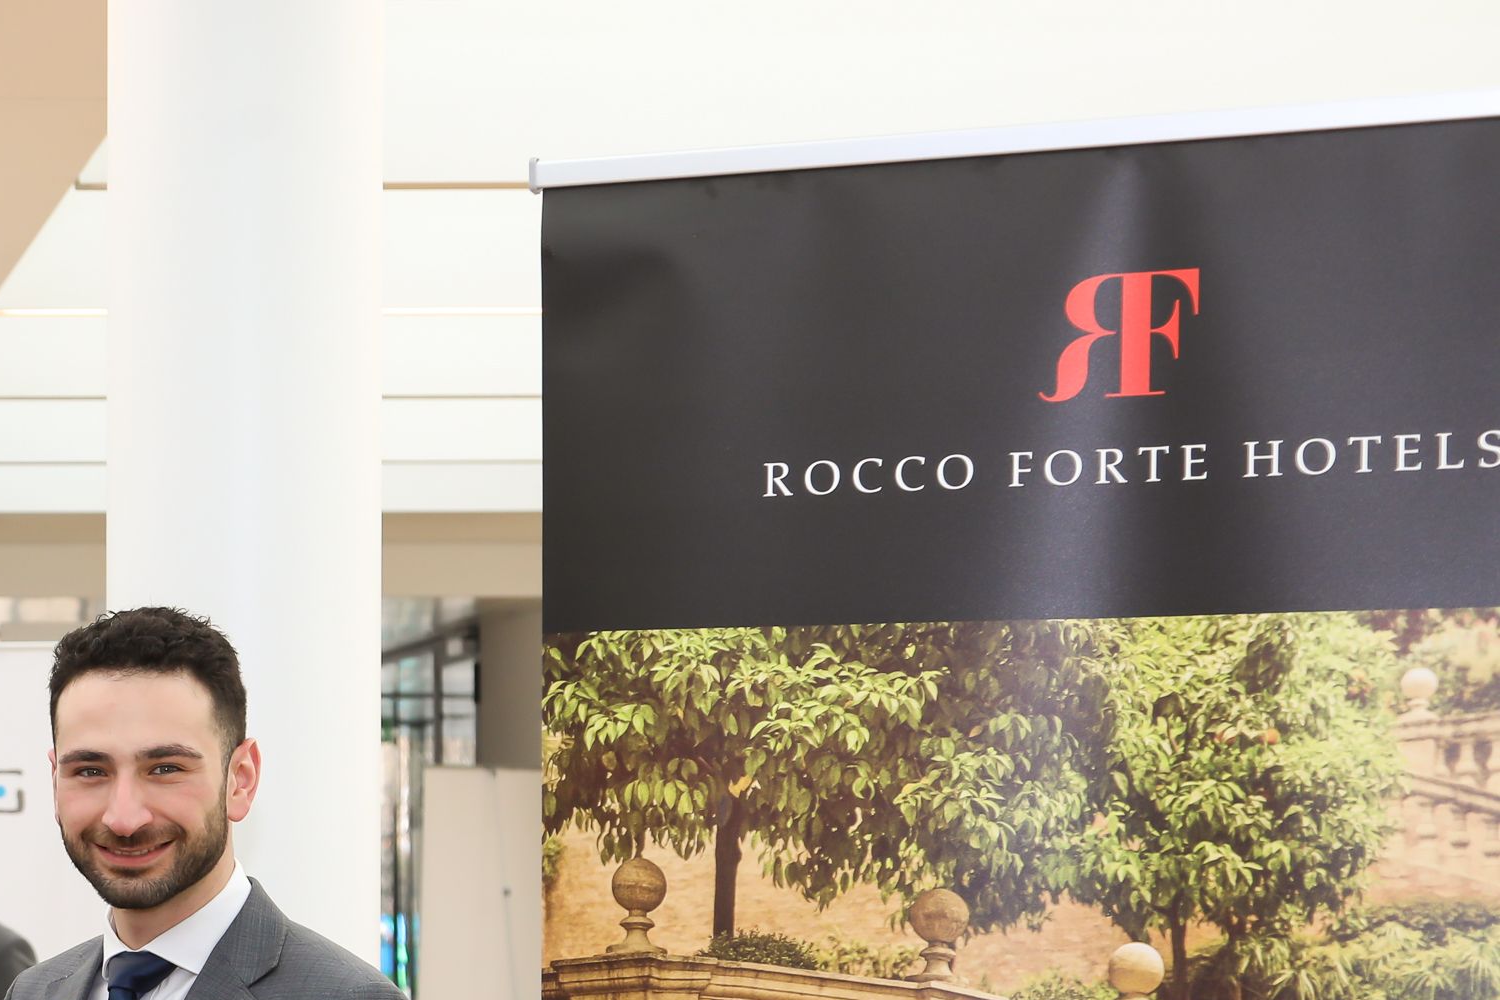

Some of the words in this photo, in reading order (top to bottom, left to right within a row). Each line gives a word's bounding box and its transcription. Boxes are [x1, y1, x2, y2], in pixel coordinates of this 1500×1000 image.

[763, 454, 975, 498] ROCCO
[1008, 444, 1209, 488] FORTE
[1243, 430, 1500, 478] HOTELS
